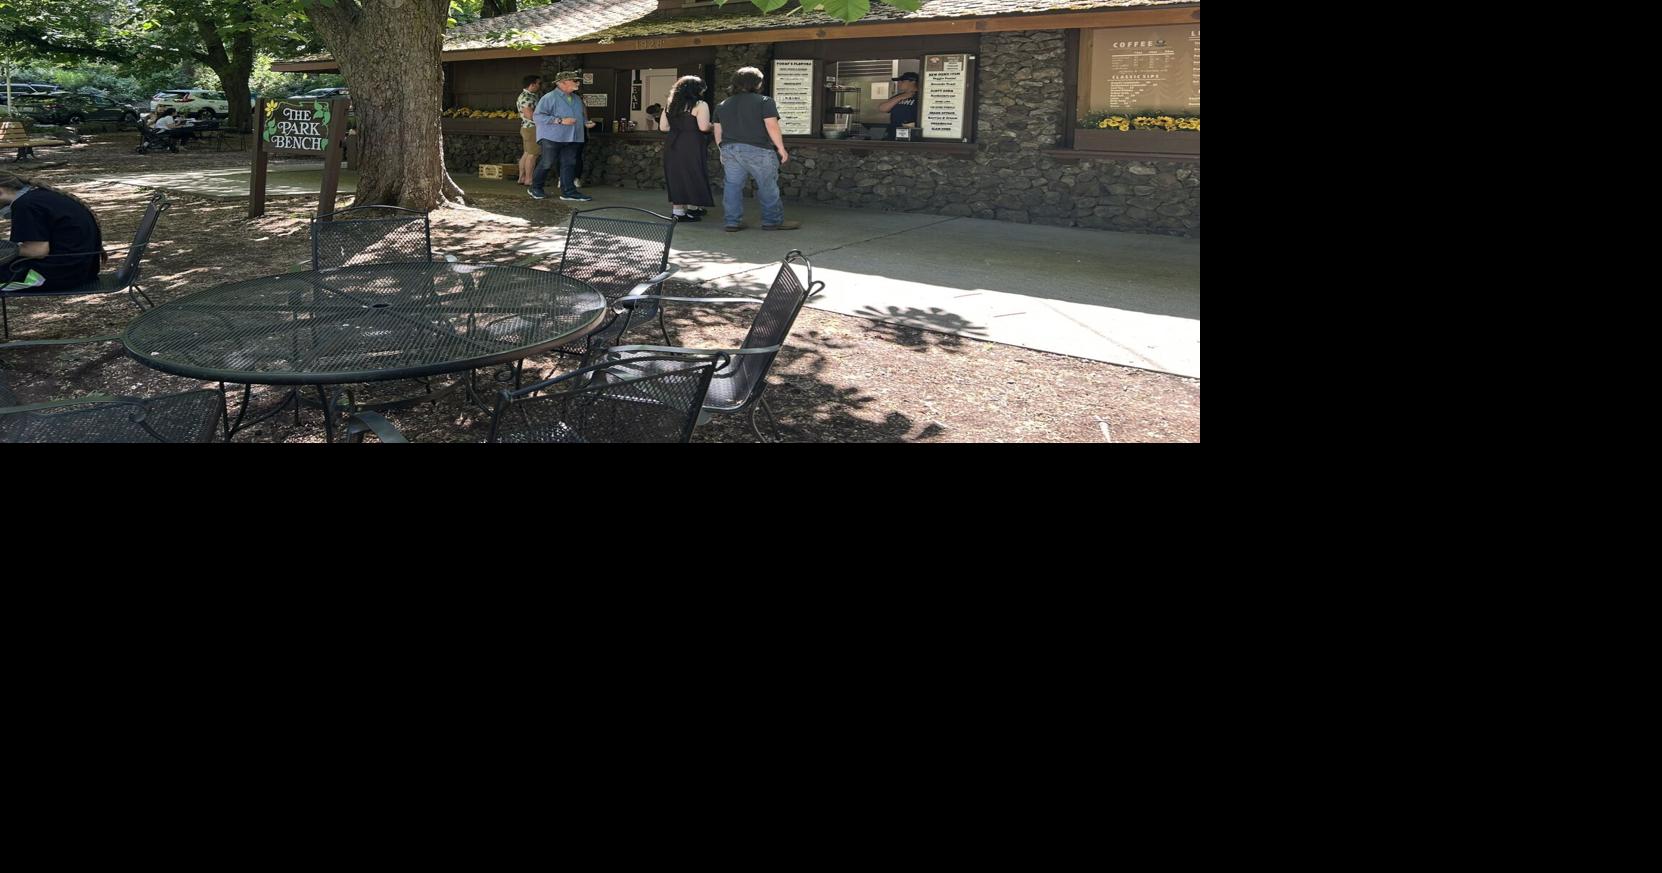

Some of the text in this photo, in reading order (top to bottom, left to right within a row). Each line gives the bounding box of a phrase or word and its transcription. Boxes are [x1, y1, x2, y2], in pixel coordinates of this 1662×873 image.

[283, 107, 312, 121] THE
[277, 121, 321, 136] PARK
[270, 135, 322, 150] BENCH
